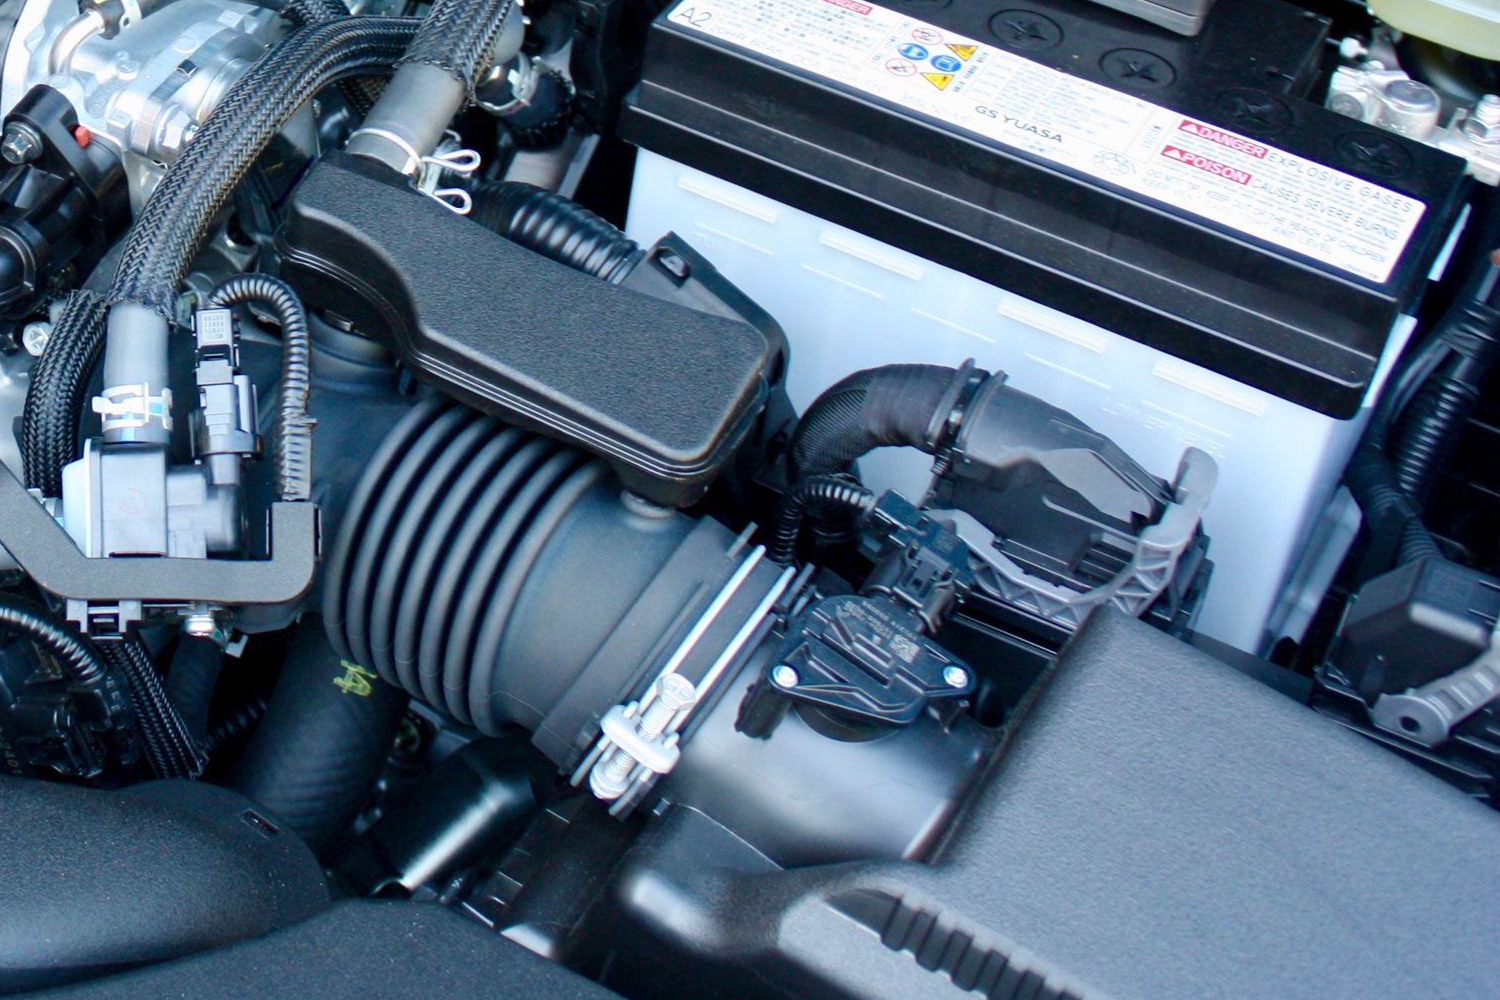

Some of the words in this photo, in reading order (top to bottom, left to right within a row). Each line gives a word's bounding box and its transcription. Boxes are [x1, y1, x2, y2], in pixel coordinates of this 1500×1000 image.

[675, 7, 713, 28] A2
[974, 105, 998, 119] GS
[1002, 114, 1064, 143] YUASA
[1180, 153, 1250, 184] POISON
[1250, 175, 1301, 203] CAUSES
[1303, 197, 1353, 223] SEVERE
[1354, 216, 1400, 241] BURNS
[1199, 127, 1266, 158] DANGER
[1268, 152, 1352, 190] EXPLOSIVE
[1358, 185, 1413, 213] GASES
